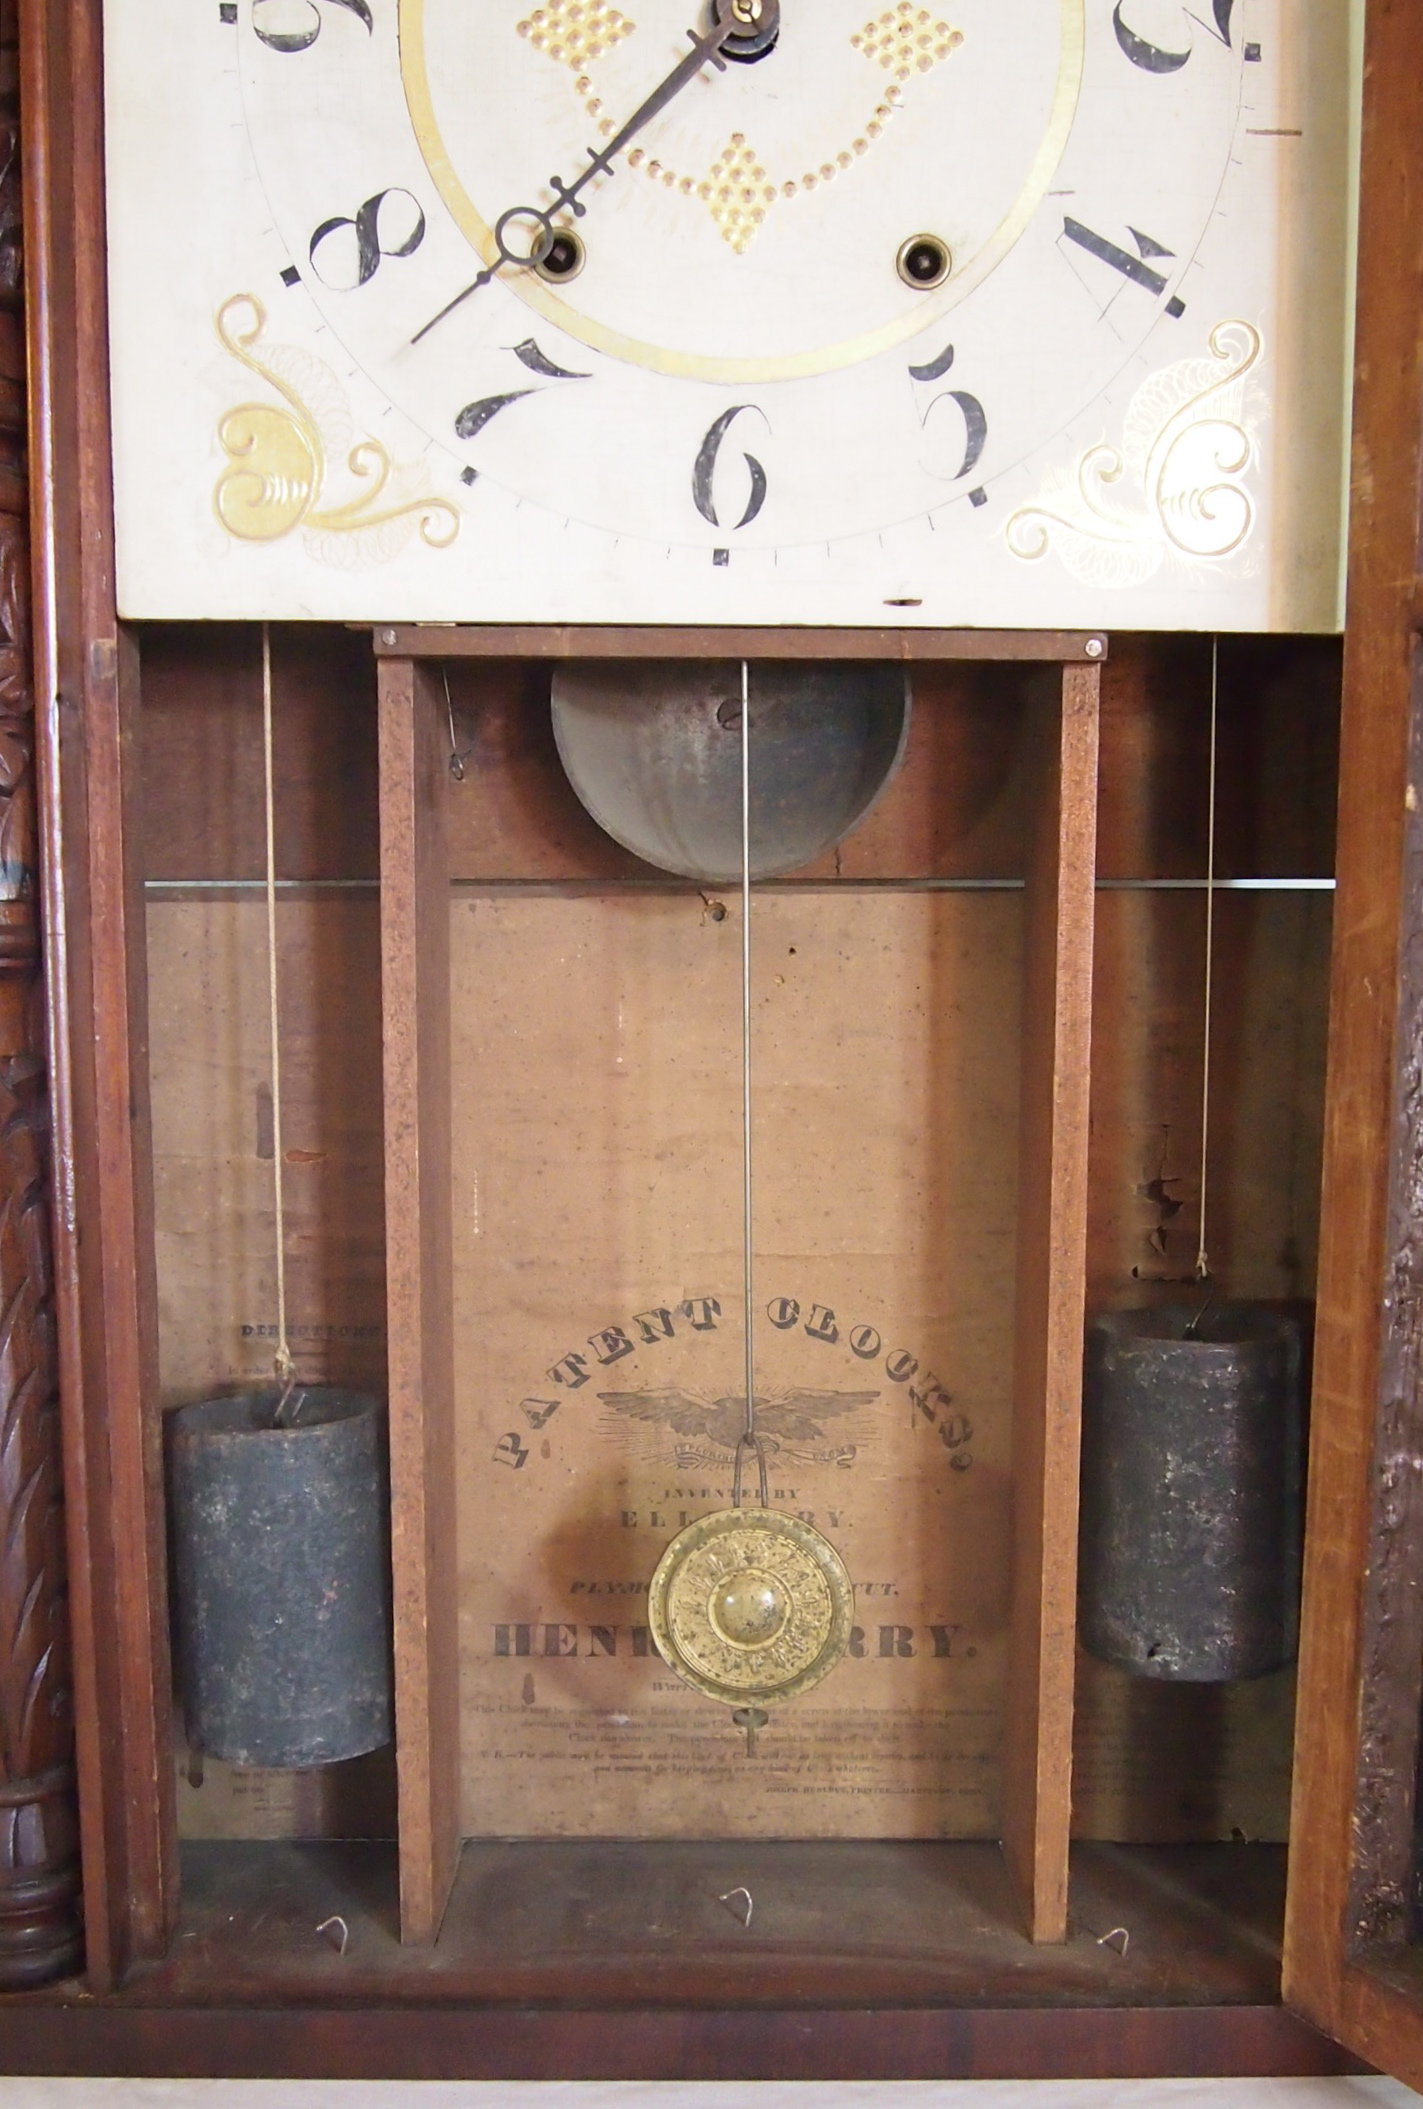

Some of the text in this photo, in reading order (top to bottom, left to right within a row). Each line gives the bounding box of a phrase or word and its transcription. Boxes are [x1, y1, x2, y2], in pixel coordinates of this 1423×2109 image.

[309, 187, 426, 291] 8
[1056, 215, 1177, 343] 4
[454, 338, 593, 440] 7
[907, 343, 988, 481] 5
[691, 404, 772, 530] 6
[492, 1297, 722, 1470] PATENT
[773, 1488, 801, 1499] BY
